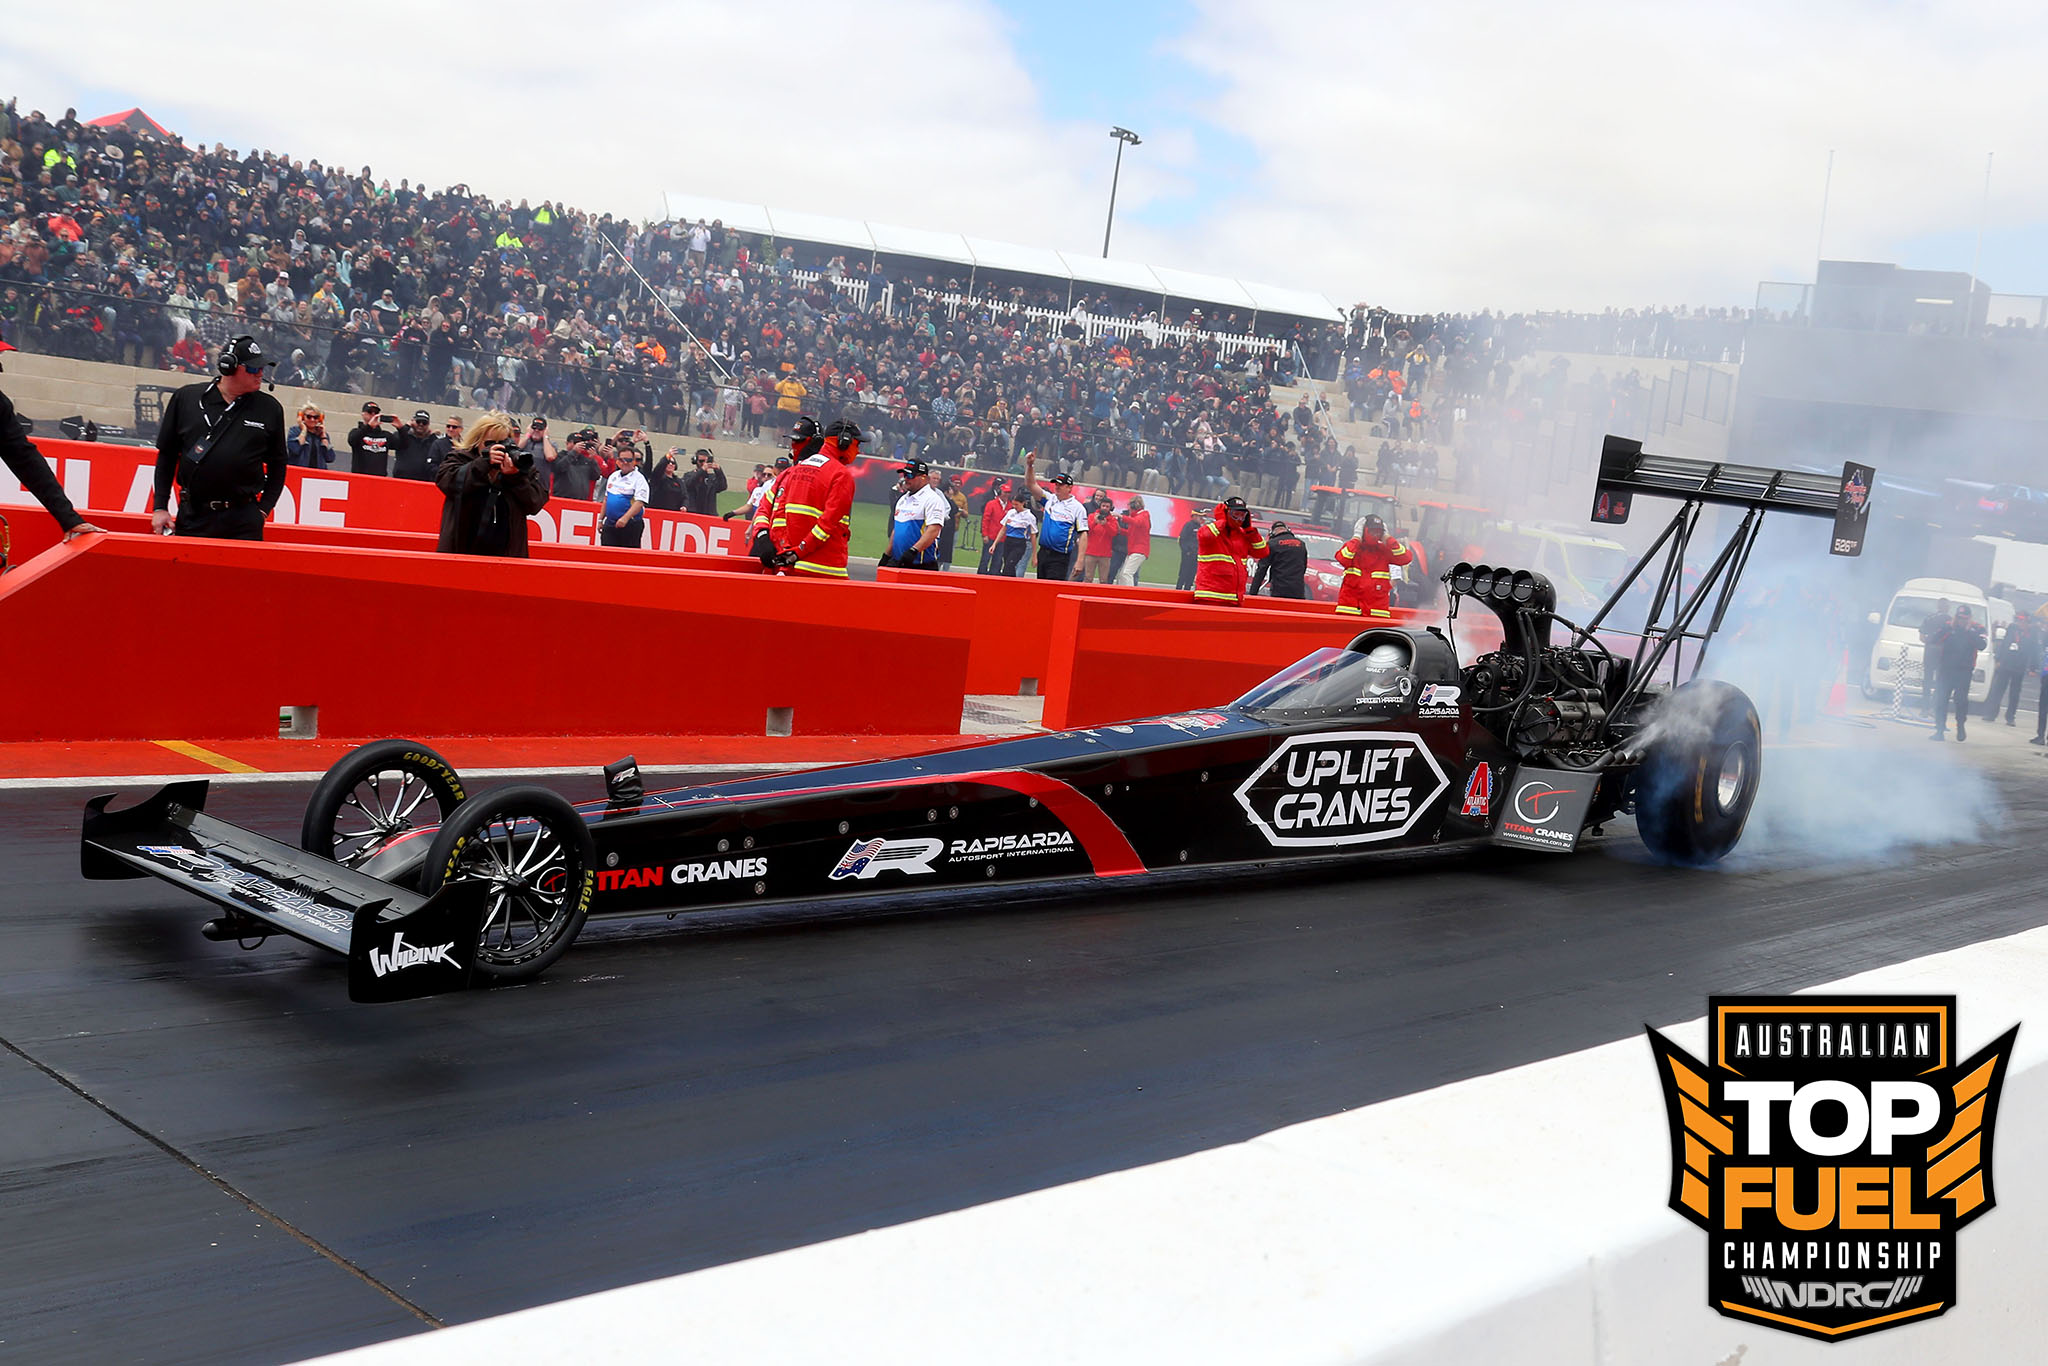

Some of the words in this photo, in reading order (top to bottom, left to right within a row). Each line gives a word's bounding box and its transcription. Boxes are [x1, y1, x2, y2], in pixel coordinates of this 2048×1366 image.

[1834, 538, 1851, 553] 526
[403, 751, 466, 801] GOODYEAR
[1287, 747, 1415, 787] UPLIFT
[1273, 787, 1412, 830] CRANES
[1467, 796, 1487, 807] ATLANTIC
[950, 831, 1074, 855] RAPISARDA
[1504, 822, 1534, 834] TITAN
[1535, 828, 1574, 841] CRANES
[948, 852, 1003, 863] AUTOSPORT
[1006, 846, 1074, 858] INTERNATIONAL
[596, 867, 664, 891] ITAN
[671, 857, 768, 884] CRANES
[578, 869, 594, 913] EAGLE
